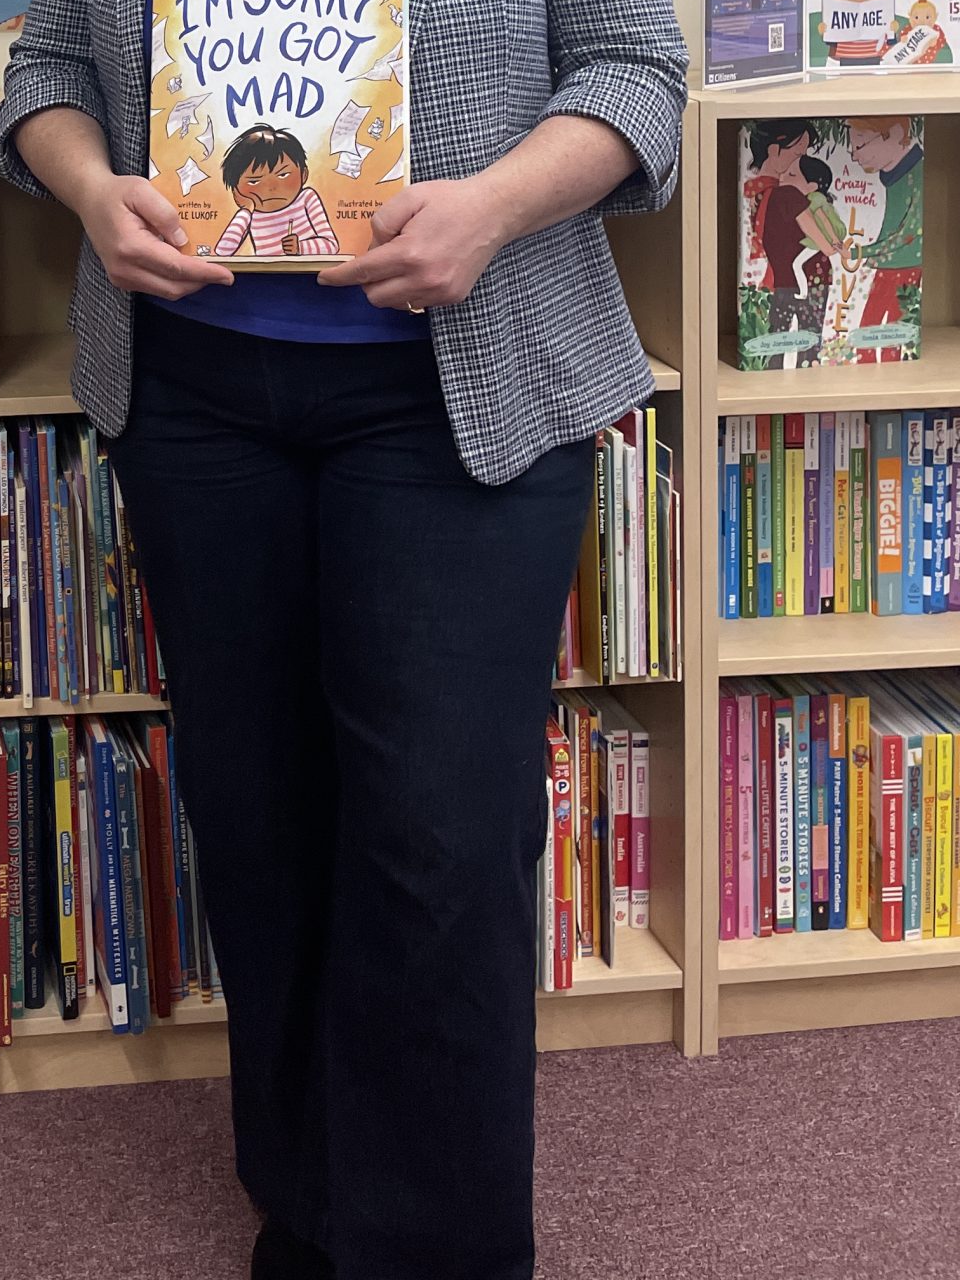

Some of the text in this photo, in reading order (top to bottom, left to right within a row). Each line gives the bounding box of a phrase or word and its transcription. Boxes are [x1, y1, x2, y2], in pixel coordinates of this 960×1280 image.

[831, 10, 887, 29] ANY AGE.
[184, 22, 376, 86] YOU GOT
[894, 45, 909, 64] ANY
[715, 73, 737, 82] Citizens
[226, 72, 324, 128] MAD
[843, 165, 849, 176] A
[835, 177, 873, 196] Crazy-
[178, 201, 211, 210] written by
[338, 200, 373, 208] illustrated
[845, 193, 877, 207] much
[178, 211, 217, 220] YLE LUKOFF
[336, 211, 375, 220] JULIE KW
[832, 207, 864, 332] LOVE
[878, 479, 900, 556] BIGGIE!
[580, 718, 590, 798] Stories from India
[559, 782, 567, 791] P
[779, 761, 788, 862] 5-MINUTE STORIES
[797, 757, 809, 875] 5-MINUTE STORIES
[617, 838, 625, 861] India
[636, 832, 645, 873] Australia
[890, 850, 895, 858] OF
[0, 864, 9, 918] Fairy Tales
[109, 879, 118, 925] MATHEMATICAL
[560, 911, 568, 959] PRESCHOOL
[112, 929, 121, 978] MYSTERIES
